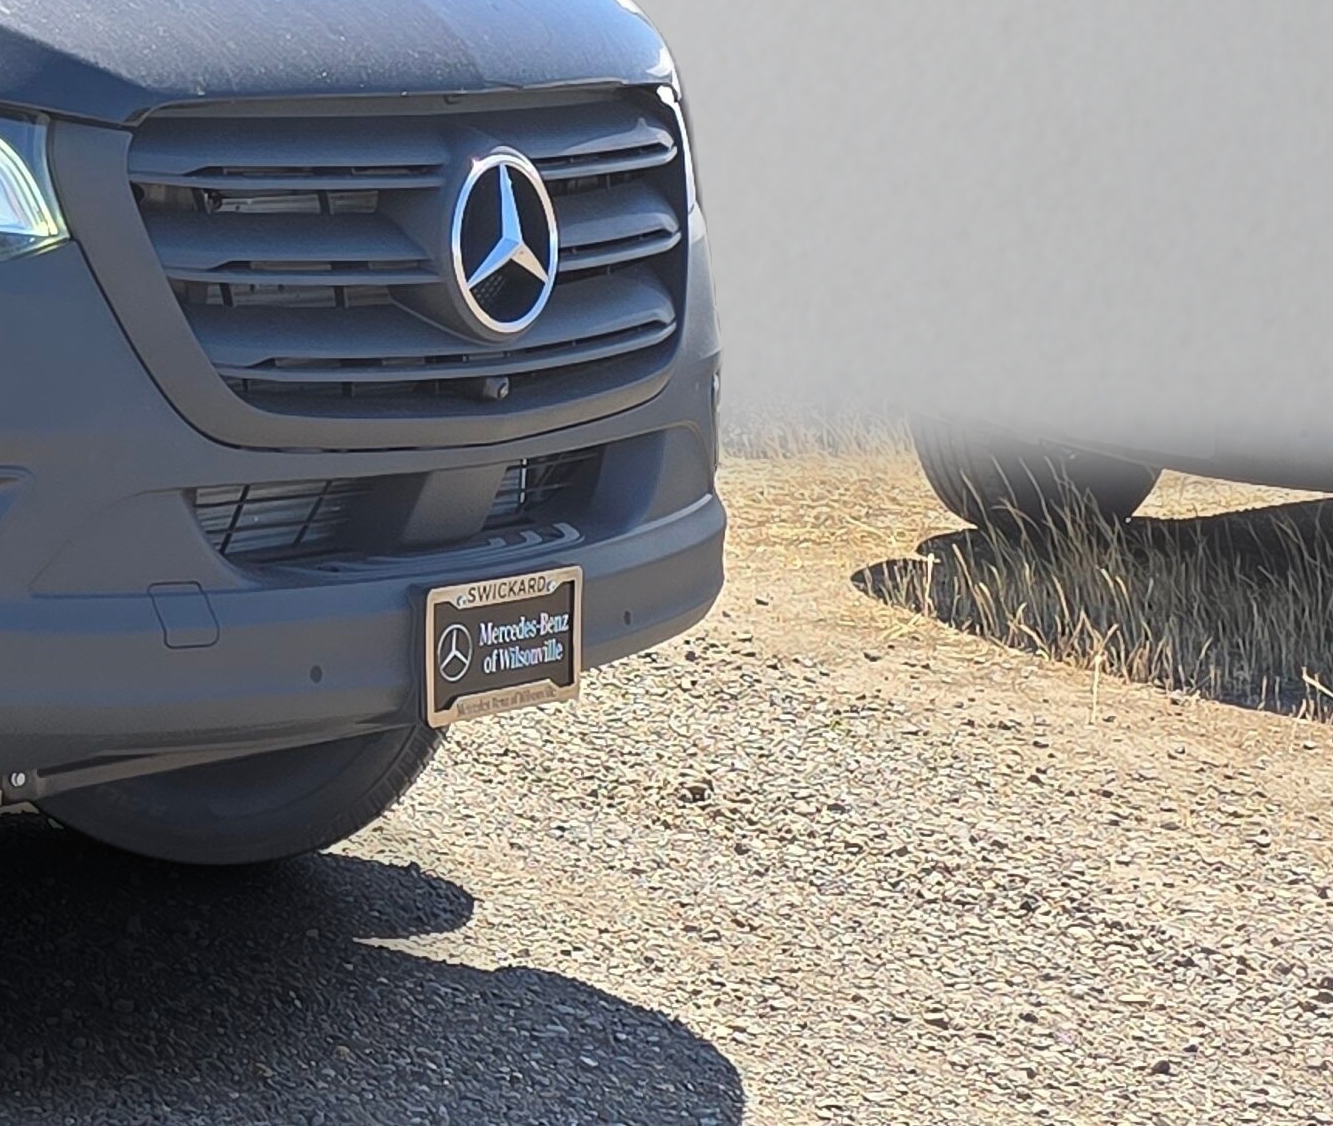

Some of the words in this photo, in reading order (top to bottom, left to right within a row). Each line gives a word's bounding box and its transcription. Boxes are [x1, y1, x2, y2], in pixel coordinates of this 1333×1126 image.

[467, 576, 546, 603] SWICKARD
[479, 612, 569, 646] Mercedes-Benz
[484, 649, 498, 673] of
[499, 638, 563, 670] Wilsonville
